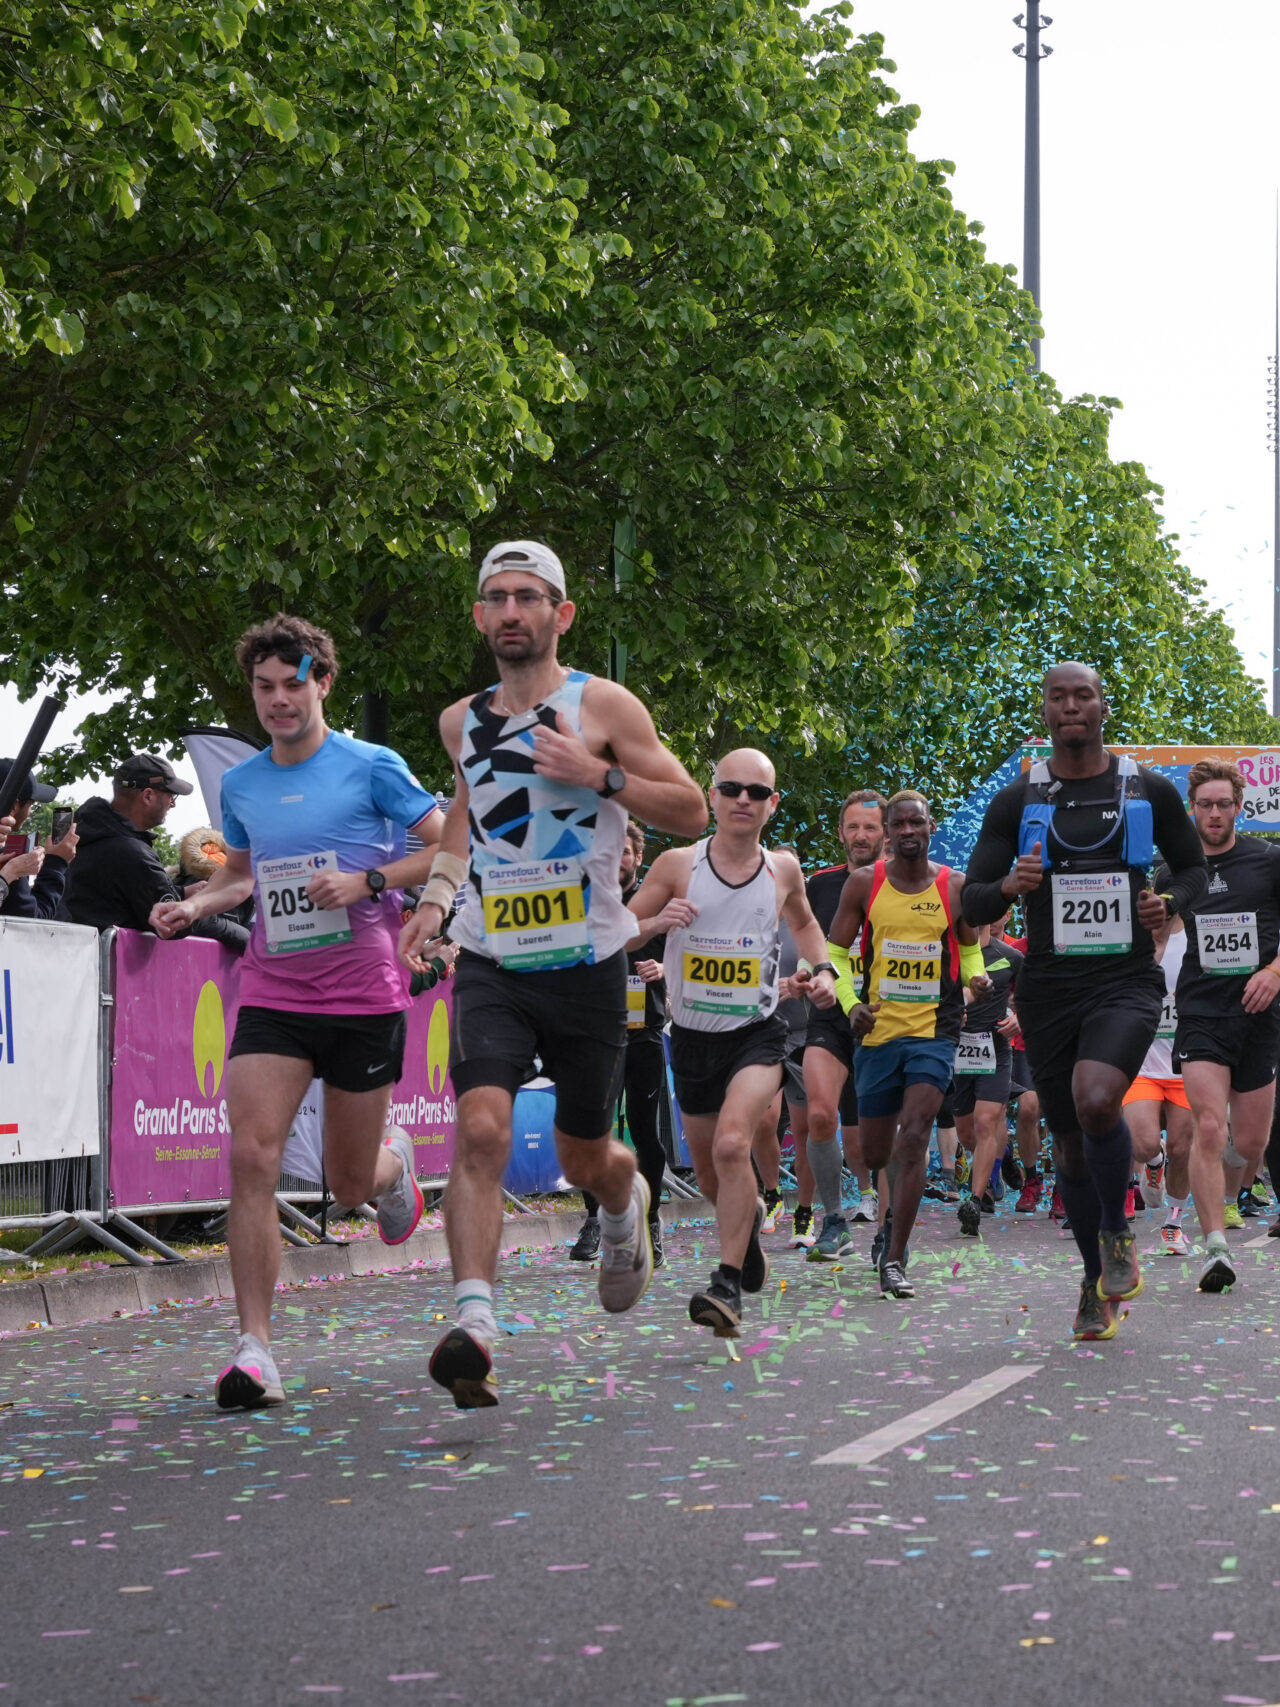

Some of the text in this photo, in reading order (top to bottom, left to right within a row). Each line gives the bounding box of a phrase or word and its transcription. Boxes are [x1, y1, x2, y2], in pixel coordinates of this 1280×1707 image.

[1260, 756, 1274, 765] LES
[1269, 787, 1280, 797] DE
[262, 862, 303, 874] Carrefour
[488, 866, 541, 879] Carrefour
[1059, 877, 1103, 885] Carrefour
[493, 890, 569, 929] 2001
[1062, 898, 1120, 924] 2201
[1200, 916, 1234, 924] Carrefour
[288, 922, 316, 932] Elouan
[517, 934, 553, 945] Laurent
[689, 935, 733, 945] Carrefour
[1203, 932, 1252, 953] 2454
[887, 942, 921, 951] Carrefour
[690, 957, 752, 985] 2005
[886, 959, 935, 979] 2014
[705, 989, 733, 998] Vincent
[958, 1044, 991, 1058] 2274
[385, 1094, 458, 1126] Grand Paris Su
[134, 1097, 180, 1136] Grand
[180, 1099, 216, 1134] Paris
